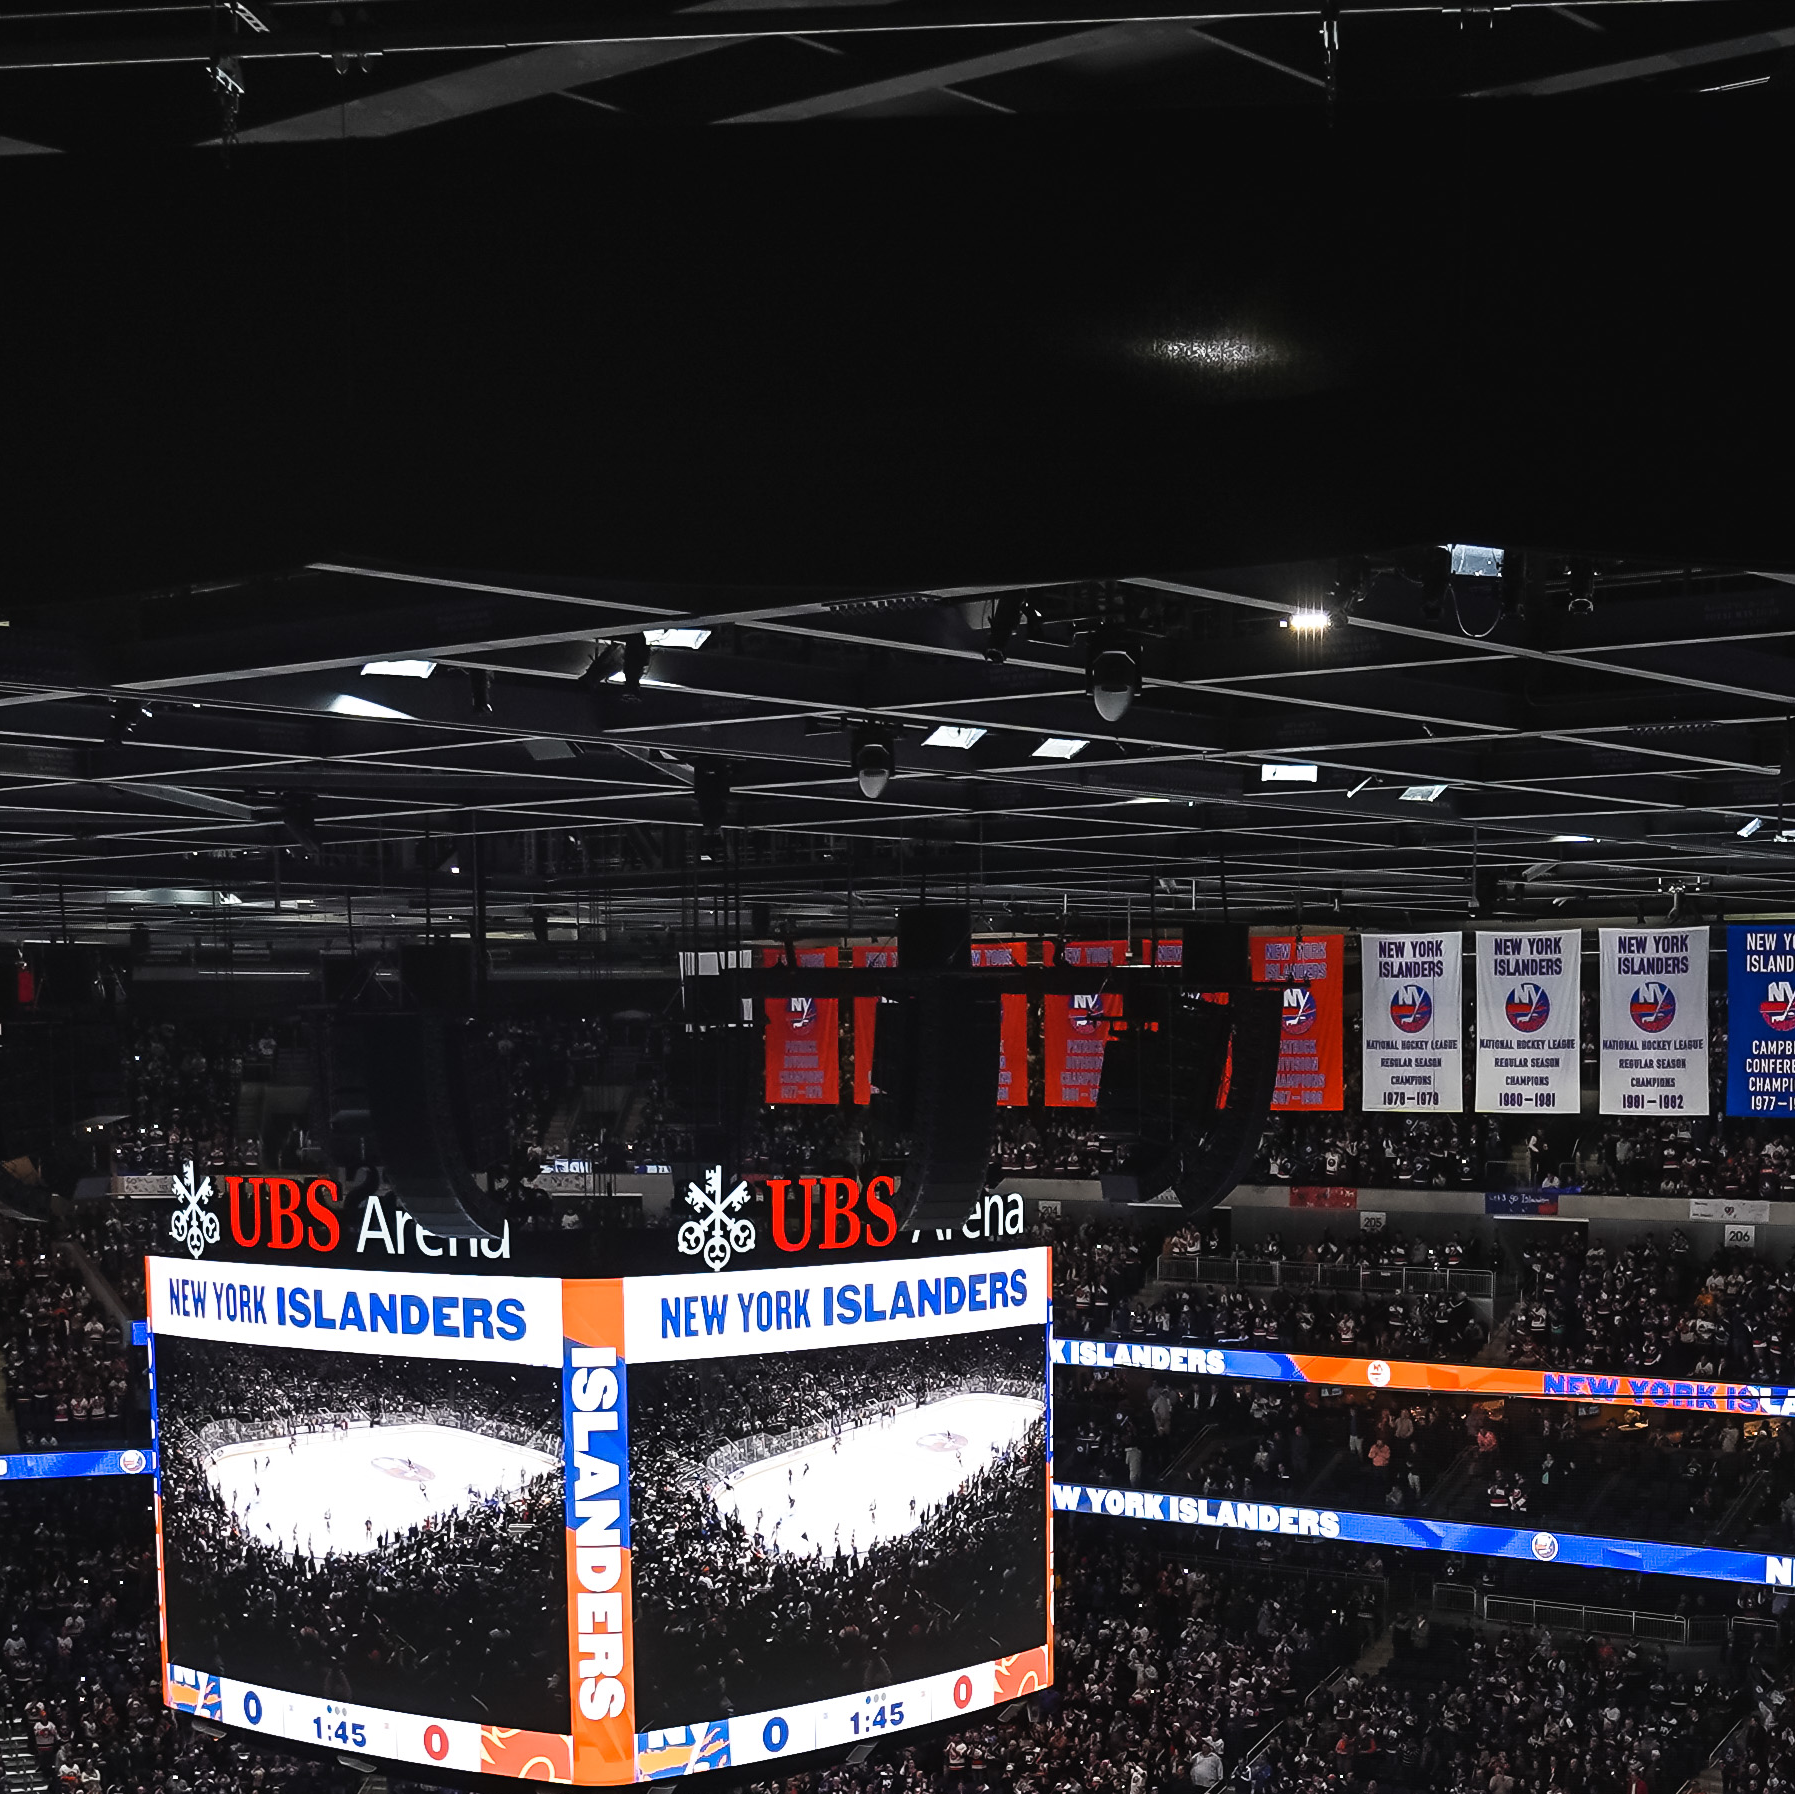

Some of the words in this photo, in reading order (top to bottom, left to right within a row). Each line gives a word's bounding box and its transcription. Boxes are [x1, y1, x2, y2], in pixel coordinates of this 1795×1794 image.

[1379, 941, 1405, 958] NEW
[1410, 940, 1443, 958] YORK
[1746, 934, 1776, 951] NEW
[225, 1176, 340, 1252] UBS
[766, 1176, 898, 1251] UBS
[1729, 1230, 1750, 1243] 206
[169, 1277, 206, 1318] NEW
[213, 1281, 267, 1325] YORK
[277, 1286, 526, 1341] ISLANDERS
[661, 1293, 729, 1339] NEW
[737, 1288, 811, 1333] YORK
[823, 1268, 1027, 1327] ISLANDERS
[1069, 1340, 1225, 1375] ISLANDERS
[1544, 1374, 1619, 1402] NEW
[1628, 1379, 1716, 1409] YORK
[1085, 1490, 1164, 1520] YORK
[1170, 1499, 1340, 1539] ISLANDERS
[570, 1346, 626, 1721] ISLANDERS
[243, 1690, 263, 1726] 0
[953, 1675, 973, 1709] 0
[313, 1716, 367, 1748] 1:45
[762, 1717, 789, 1753] 0
[849, 1702, 905, 1735] 1:45
[423, 1724, 449, 1761] 0
